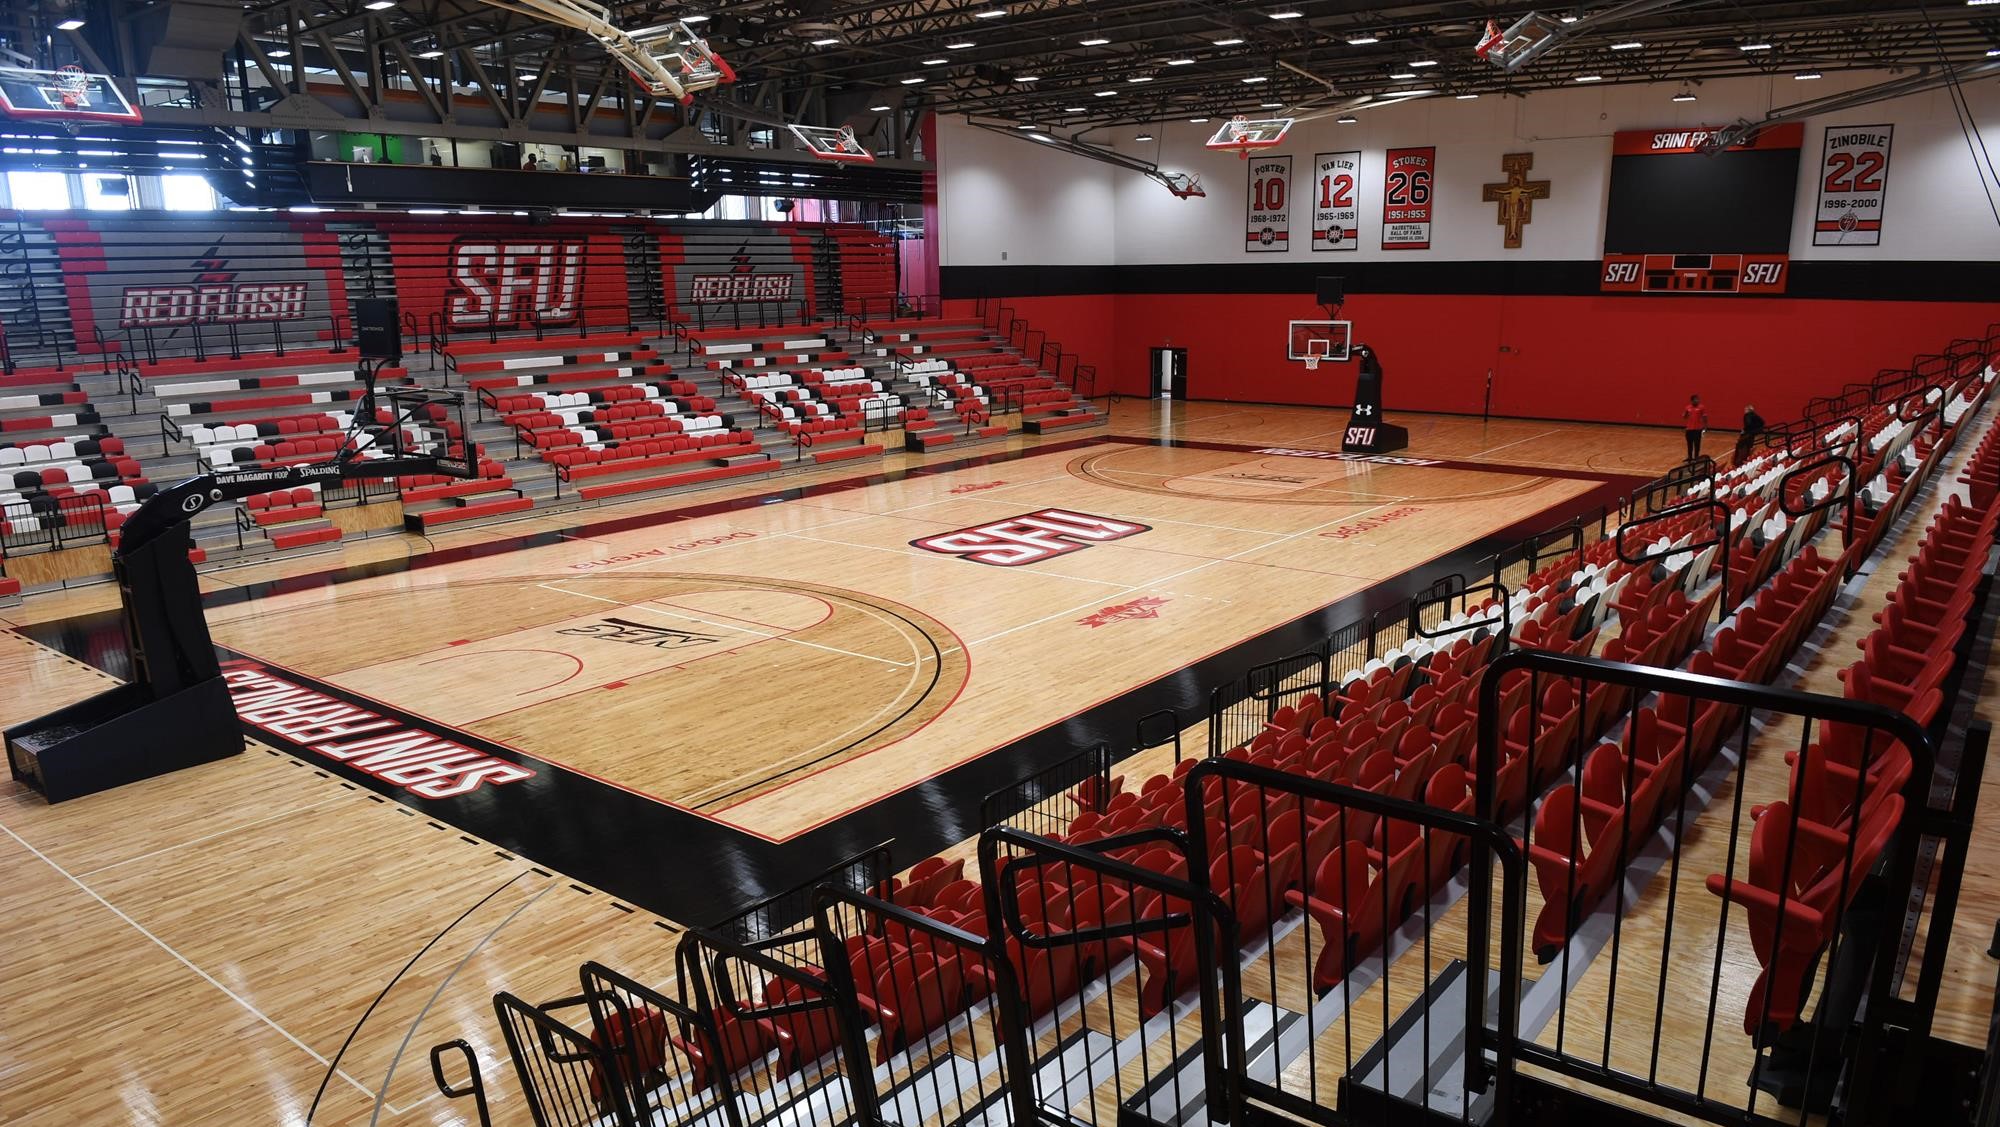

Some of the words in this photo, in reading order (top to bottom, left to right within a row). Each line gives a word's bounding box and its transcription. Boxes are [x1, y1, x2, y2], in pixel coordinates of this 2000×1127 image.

[1652, 132, 1691, 149] SAINT
[1830, 134, 1888, 149] ZINOBILE
[1255, 164, 1286, 175] PORTER
[1321, 162, 1336, 171] VAN
[1337, 161, 1354, 170] LIER
[1392, 156, 1427, 168] STOKES
[1824, 151, 1885, 193] 22
[1253, 178, 1285, 211] 10
[1320, 174, 1353, 208] 12
[1387, 170, 1431, 206] 26
[1824, 199, 1877, 208] 1996-2000
[1250, 214, 1286, 223] 1968-1972
[1317, 212, 1354, 220] 1965-1969
[1388, 210, 1426, 219] 1951-1955
[1605, 263, 1640, 282] SFU
[1743, 263, 1782, 283] SFU
[451, 244, 581, 323] SFU
[1345, 427, 1376, 445] SFU
[216, 475, 235, 484] DAVE
[236, 472, 273, 482] MAGARITY
[274, 470, 289, 479] HOOP
[300, 465, 340, 477] SPALDING
[669, 531, 758, 551] DeGol
[914, 509, 1147, 565] SFU
[568, 548, 665, 570] Arena
[311, 730, 534, 798] SAINT
